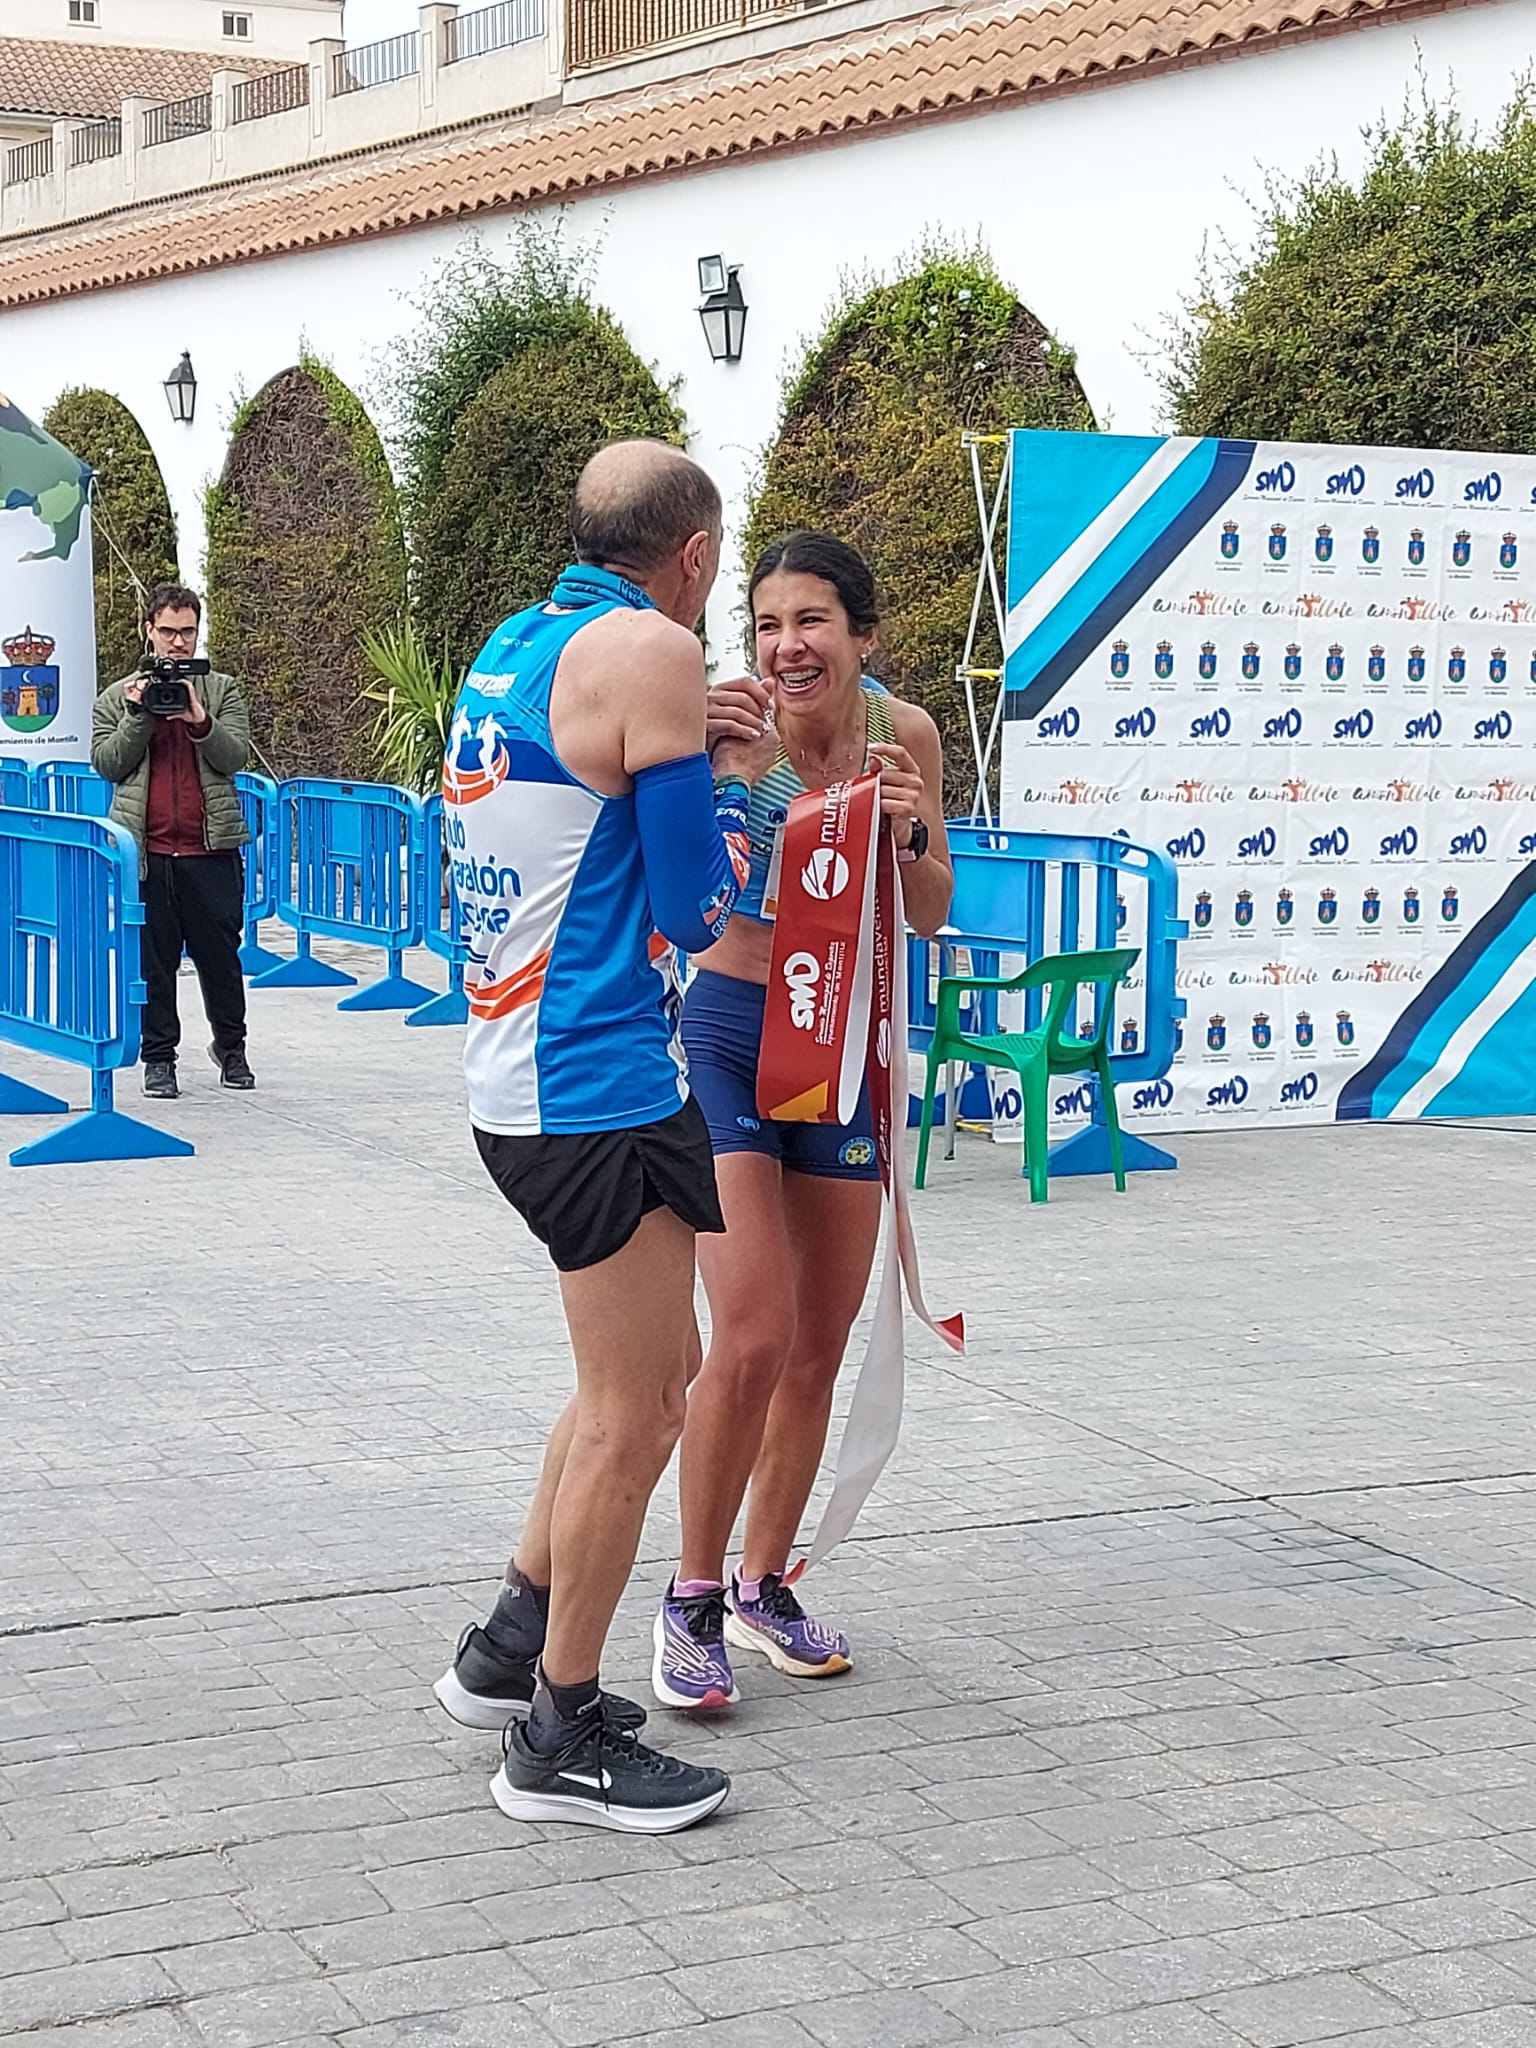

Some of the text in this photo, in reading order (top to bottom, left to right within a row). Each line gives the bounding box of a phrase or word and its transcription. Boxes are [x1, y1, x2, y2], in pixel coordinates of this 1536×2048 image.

[447, 811, 465, 850] lub
[453, 854, 522, 898] aratón
[783, 951, 820, 1031] SMD
